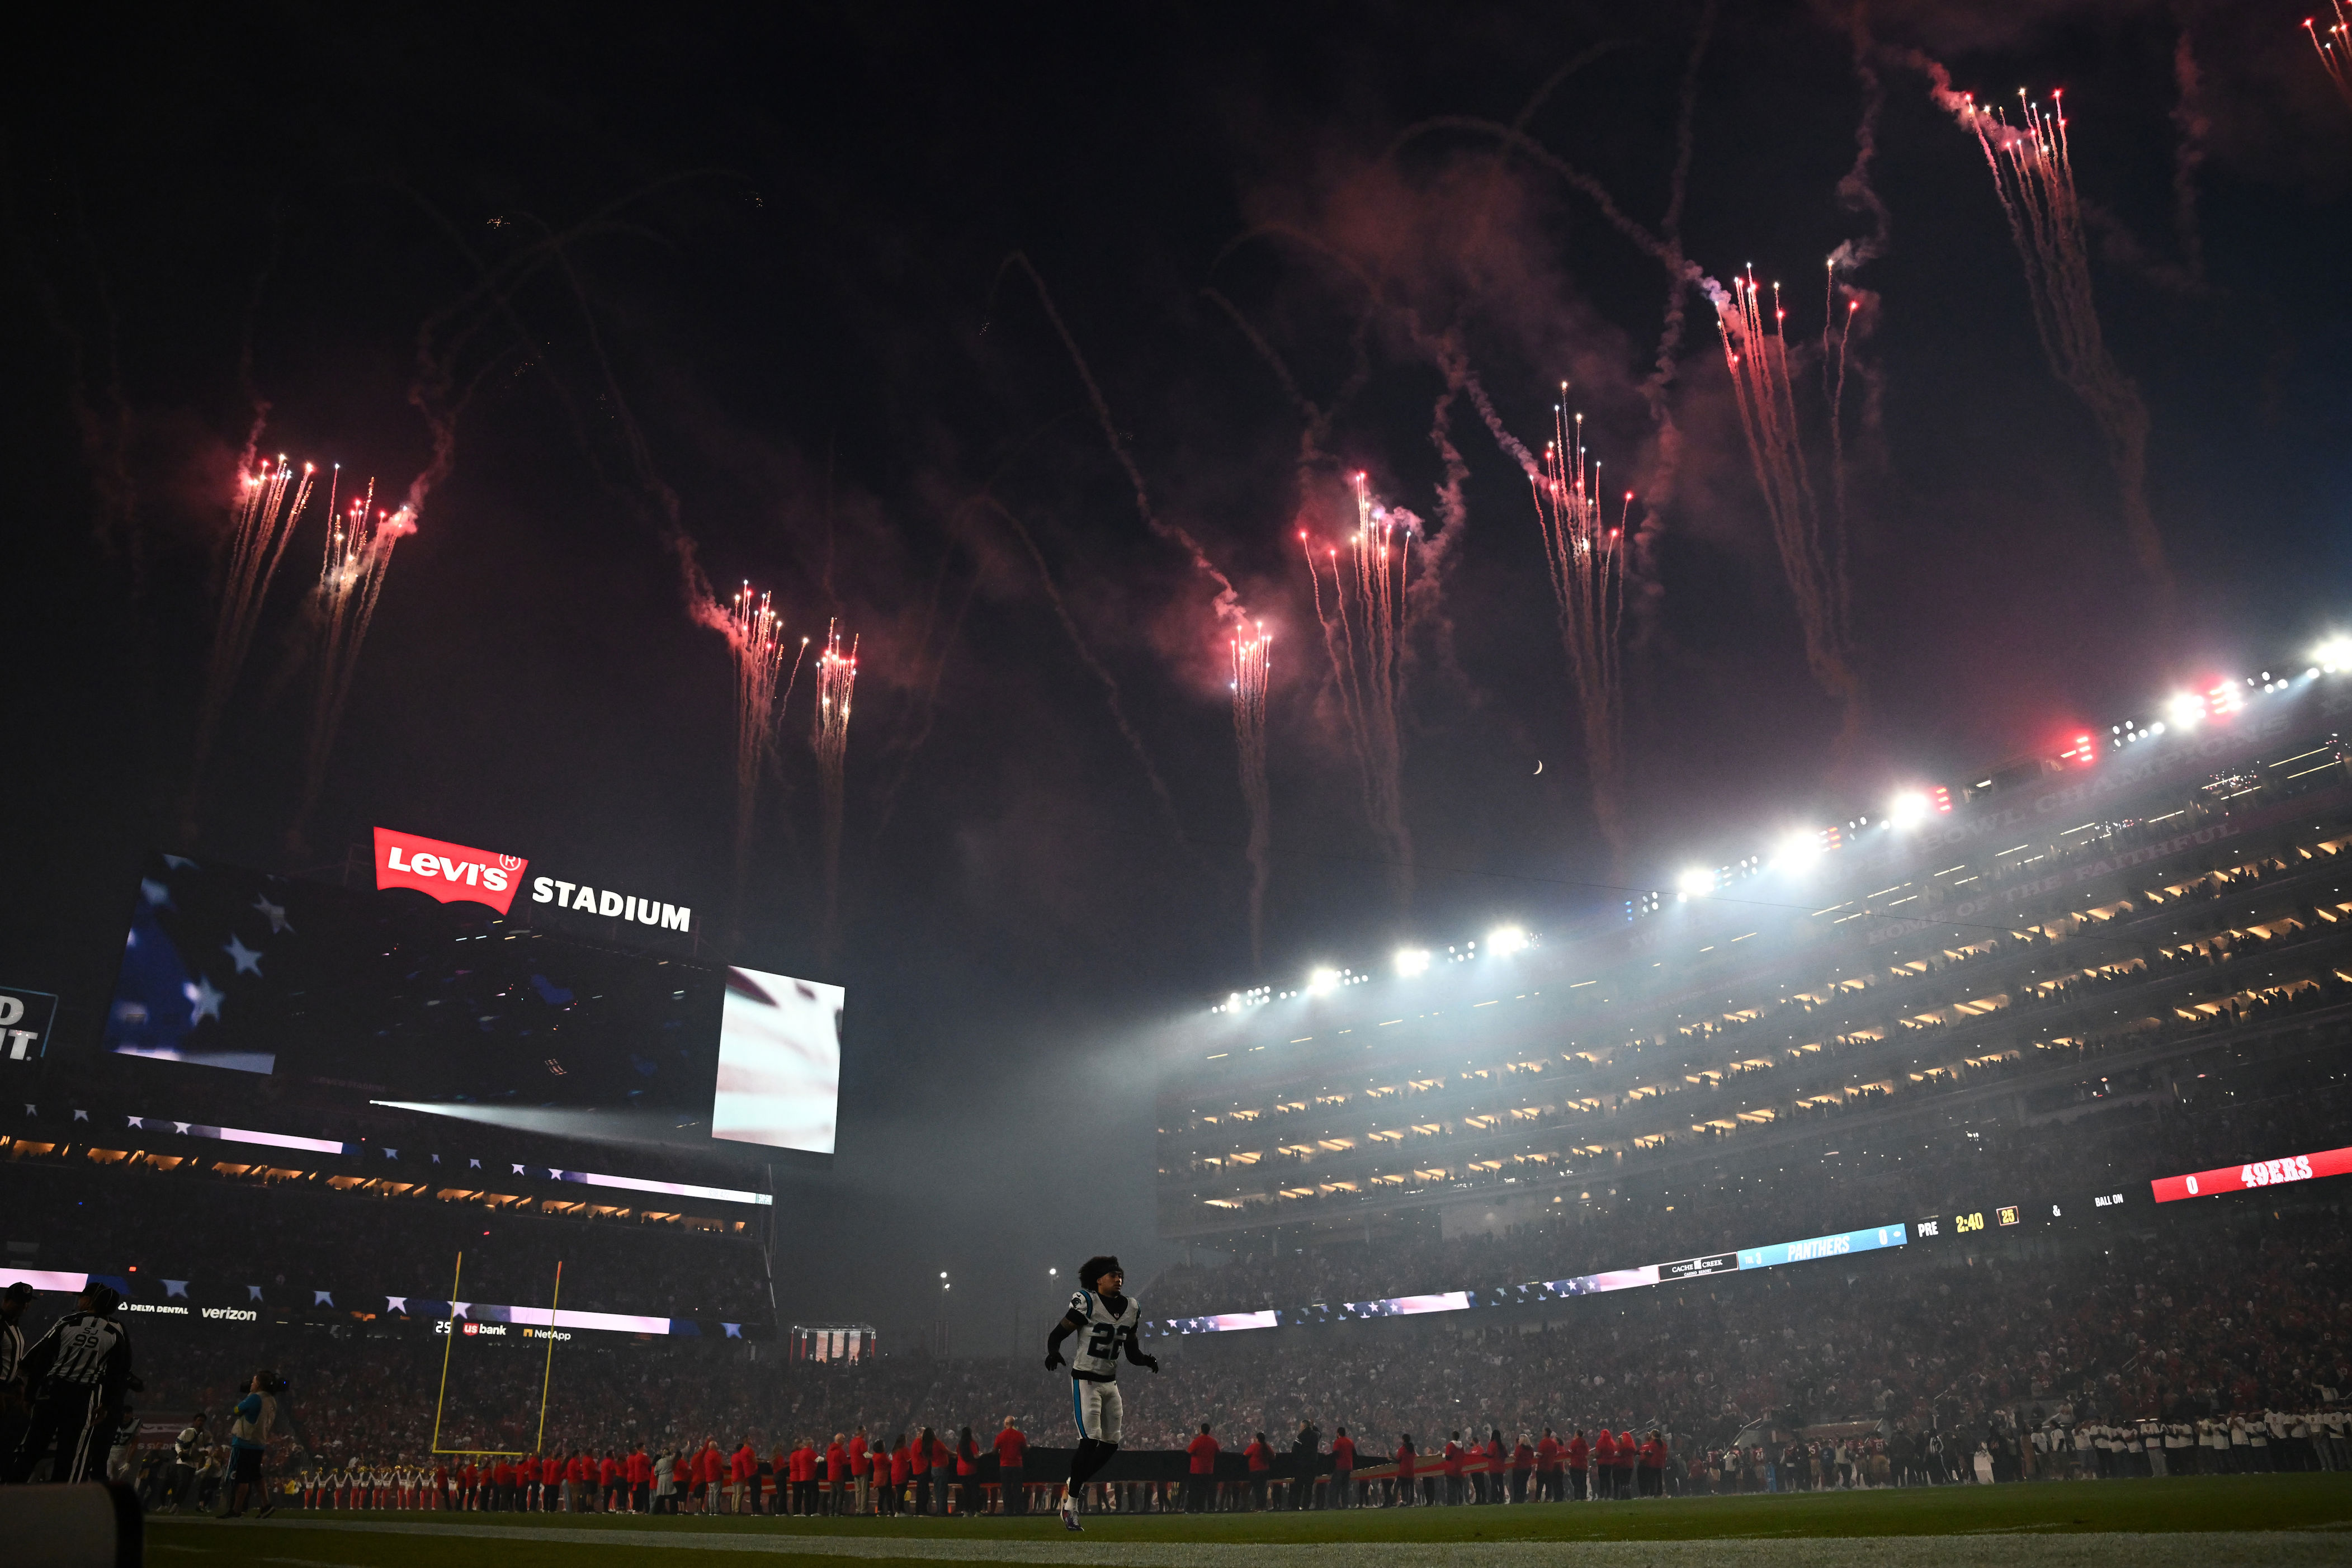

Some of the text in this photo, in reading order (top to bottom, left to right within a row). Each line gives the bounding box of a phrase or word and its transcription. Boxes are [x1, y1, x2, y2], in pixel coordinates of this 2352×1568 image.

[2001, 875, 2062, 903] THE
[2076, 822, 2240, 882] FAITHFUL
[532, 876, 691, 932] STADIUM
[2186, 1155, 2313, 1194] 0 49ERS
[2095, 1193, 2124, 1207] BALL ON
[2001, 1209, 2015, 1223] 25
[2053, 1205, 2061, 1217] &
[1956, 1212, 1984, 1232] 2:40
[1917, 1221, 1939, 1238] PRE
[1788, 1229, 1888, 1262] PANTHERS 0
[1756, 1252, 1762, 1265] 3
[1671, 1259, 1723, 1273] CACHE CREEK
[130, 1303, 188, 1314] DELTA DENTAL
[201, 1307, 257, 1321] verizon
[435, 1321, 452, 1334] 25
[479, 1324, 507, 1335] bank
[73, 1334, 99, 1348] 99
[534, 1329, 572, 1341] NetApp
